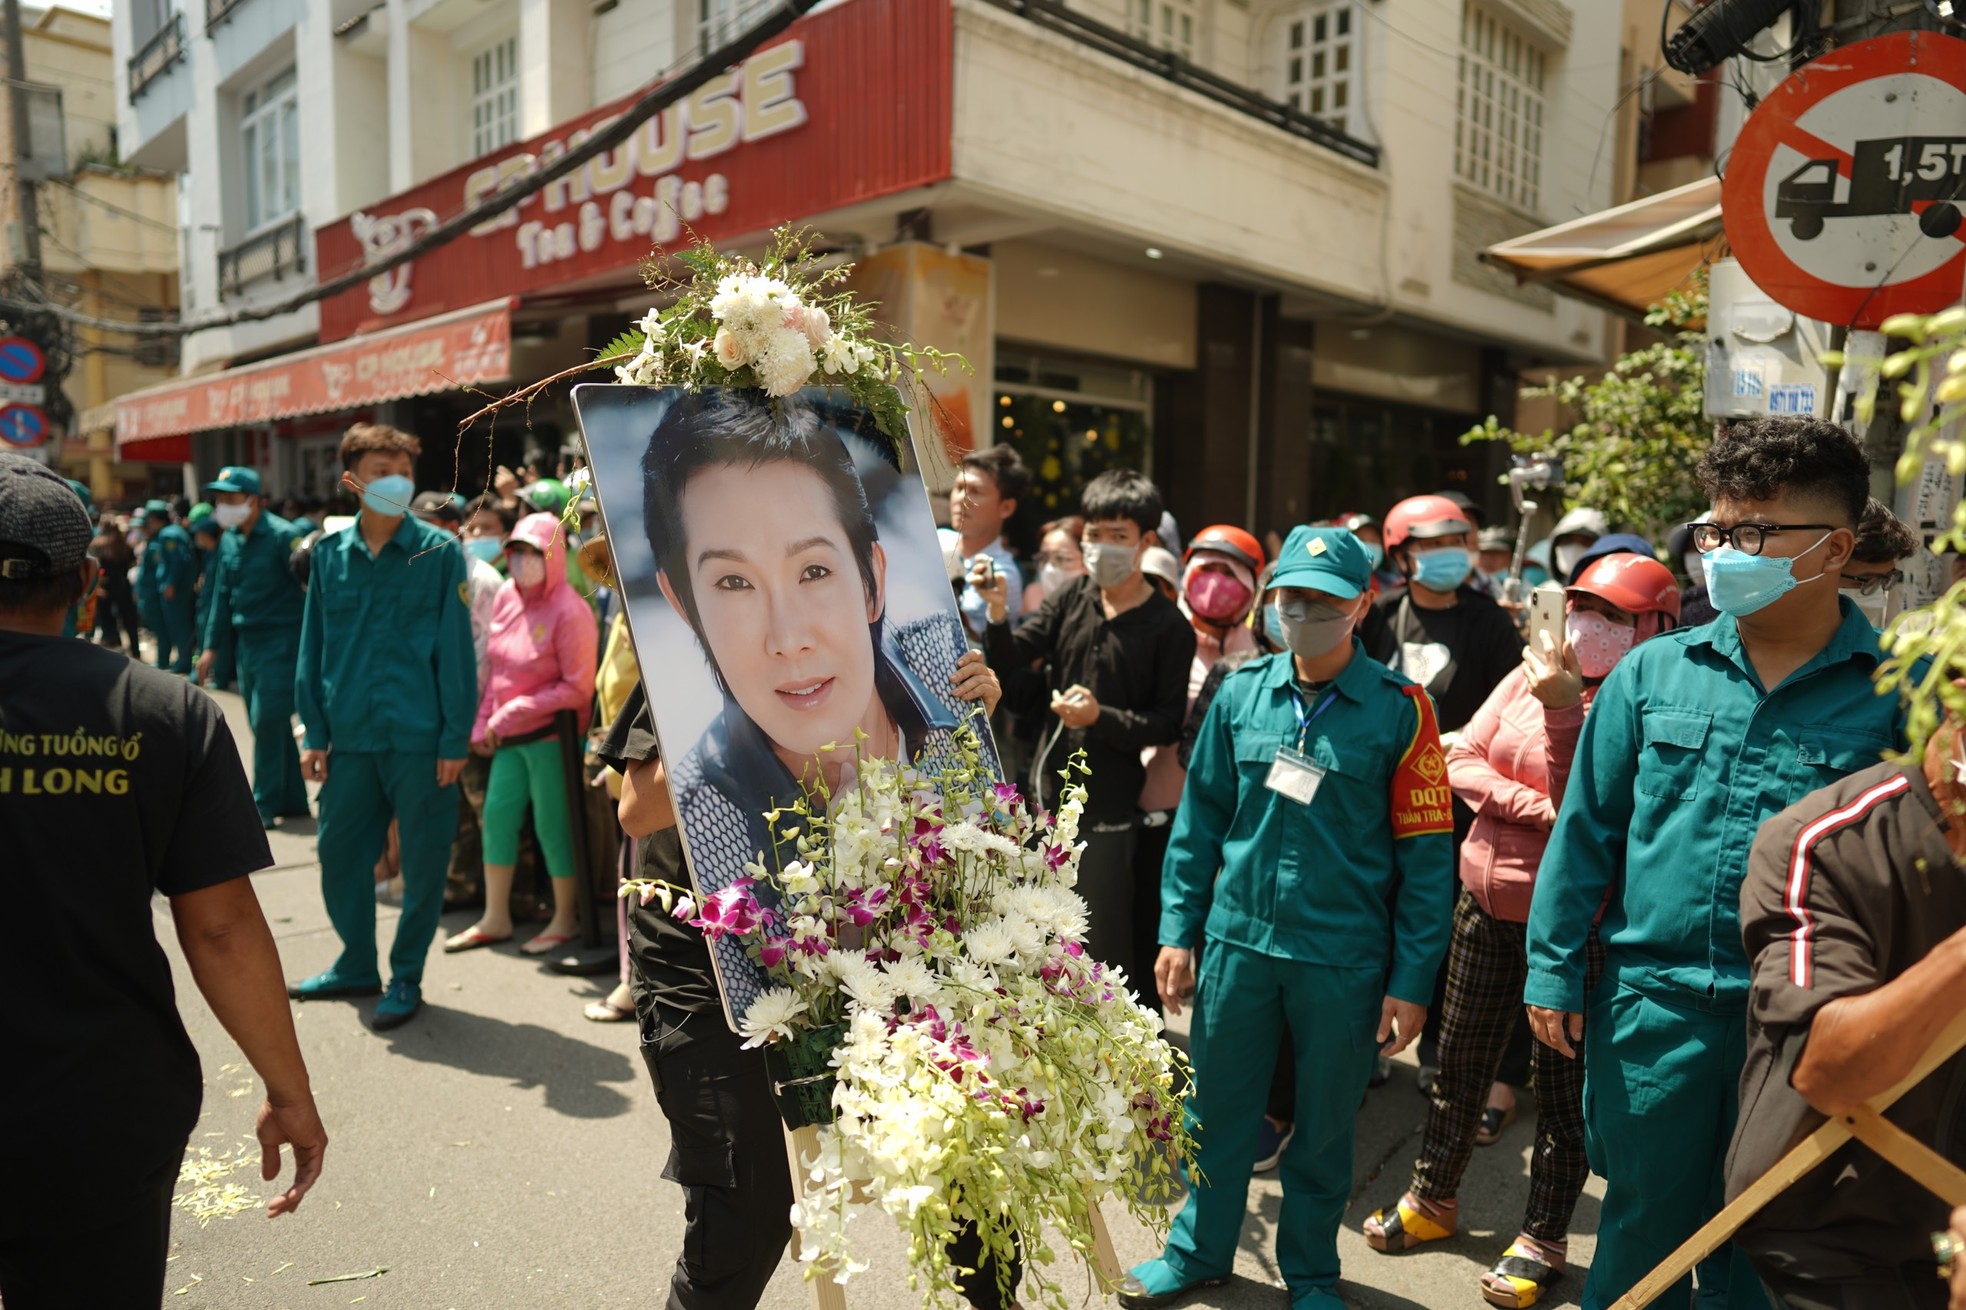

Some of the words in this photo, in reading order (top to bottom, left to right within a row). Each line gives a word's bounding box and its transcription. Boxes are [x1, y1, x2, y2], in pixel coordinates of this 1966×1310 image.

[541, 39, 809, 213] HOUSE
[1883, 143, 1966, 187] 1,5T
[516, 220, 576, 269] Tea
[578, 200, 606, 252] &
[609, 172, 729, 243] Coffee
[0, 728, 36, 756] NG
[40, 725, 118, 757] TUỒNG
[22, 767, 129, 795] LONG
